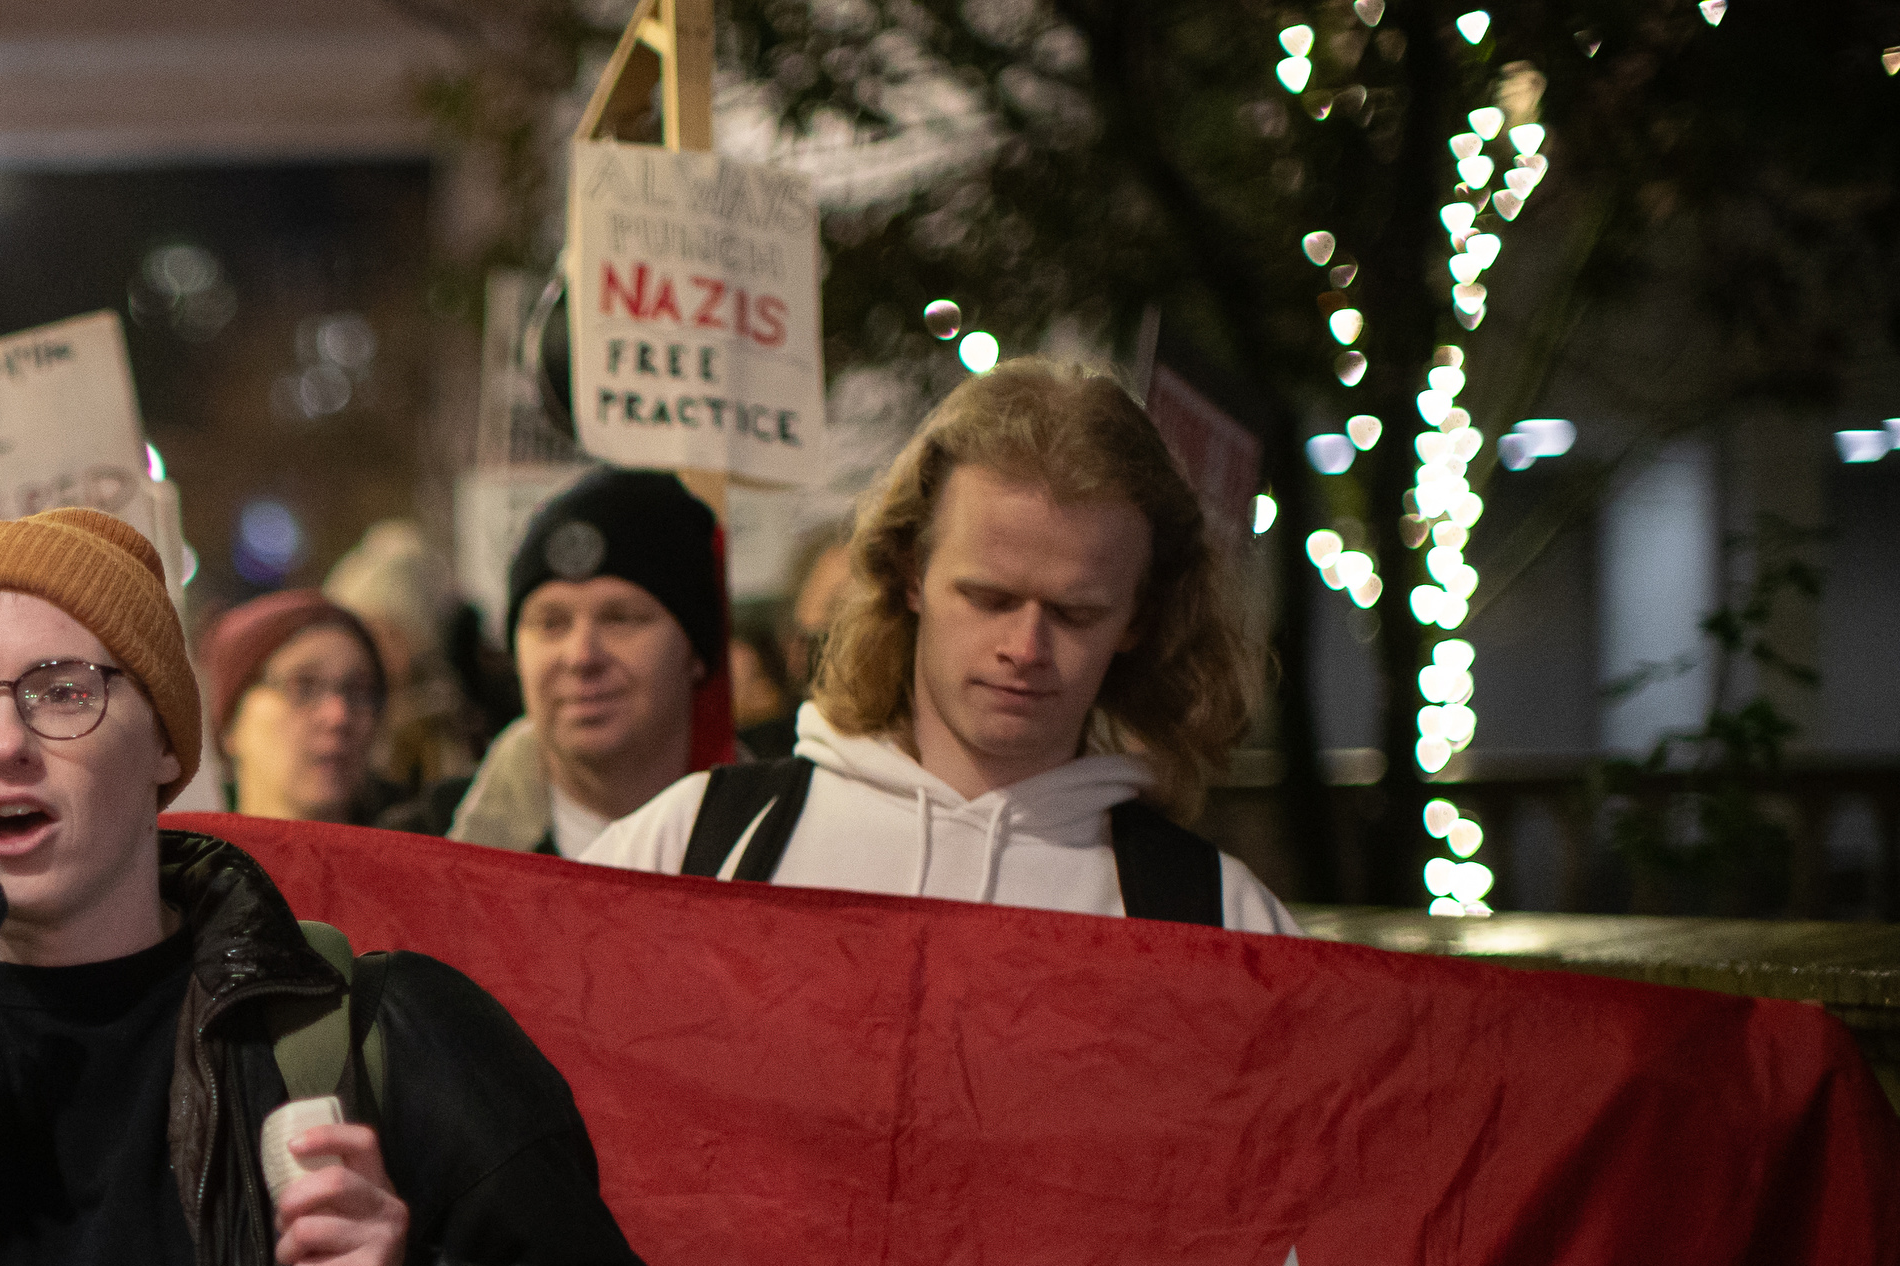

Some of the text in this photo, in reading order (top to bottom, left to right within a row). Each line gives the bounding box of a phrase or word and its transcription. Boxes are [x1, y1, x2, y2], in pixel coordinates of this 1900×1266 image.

[607, 211, 785, 279] PUNCH
[600, 260, 789, 347] NAZIS
[605, 338, 720, 383] FREE
[597, 386, 803, 447] PRACTICE
